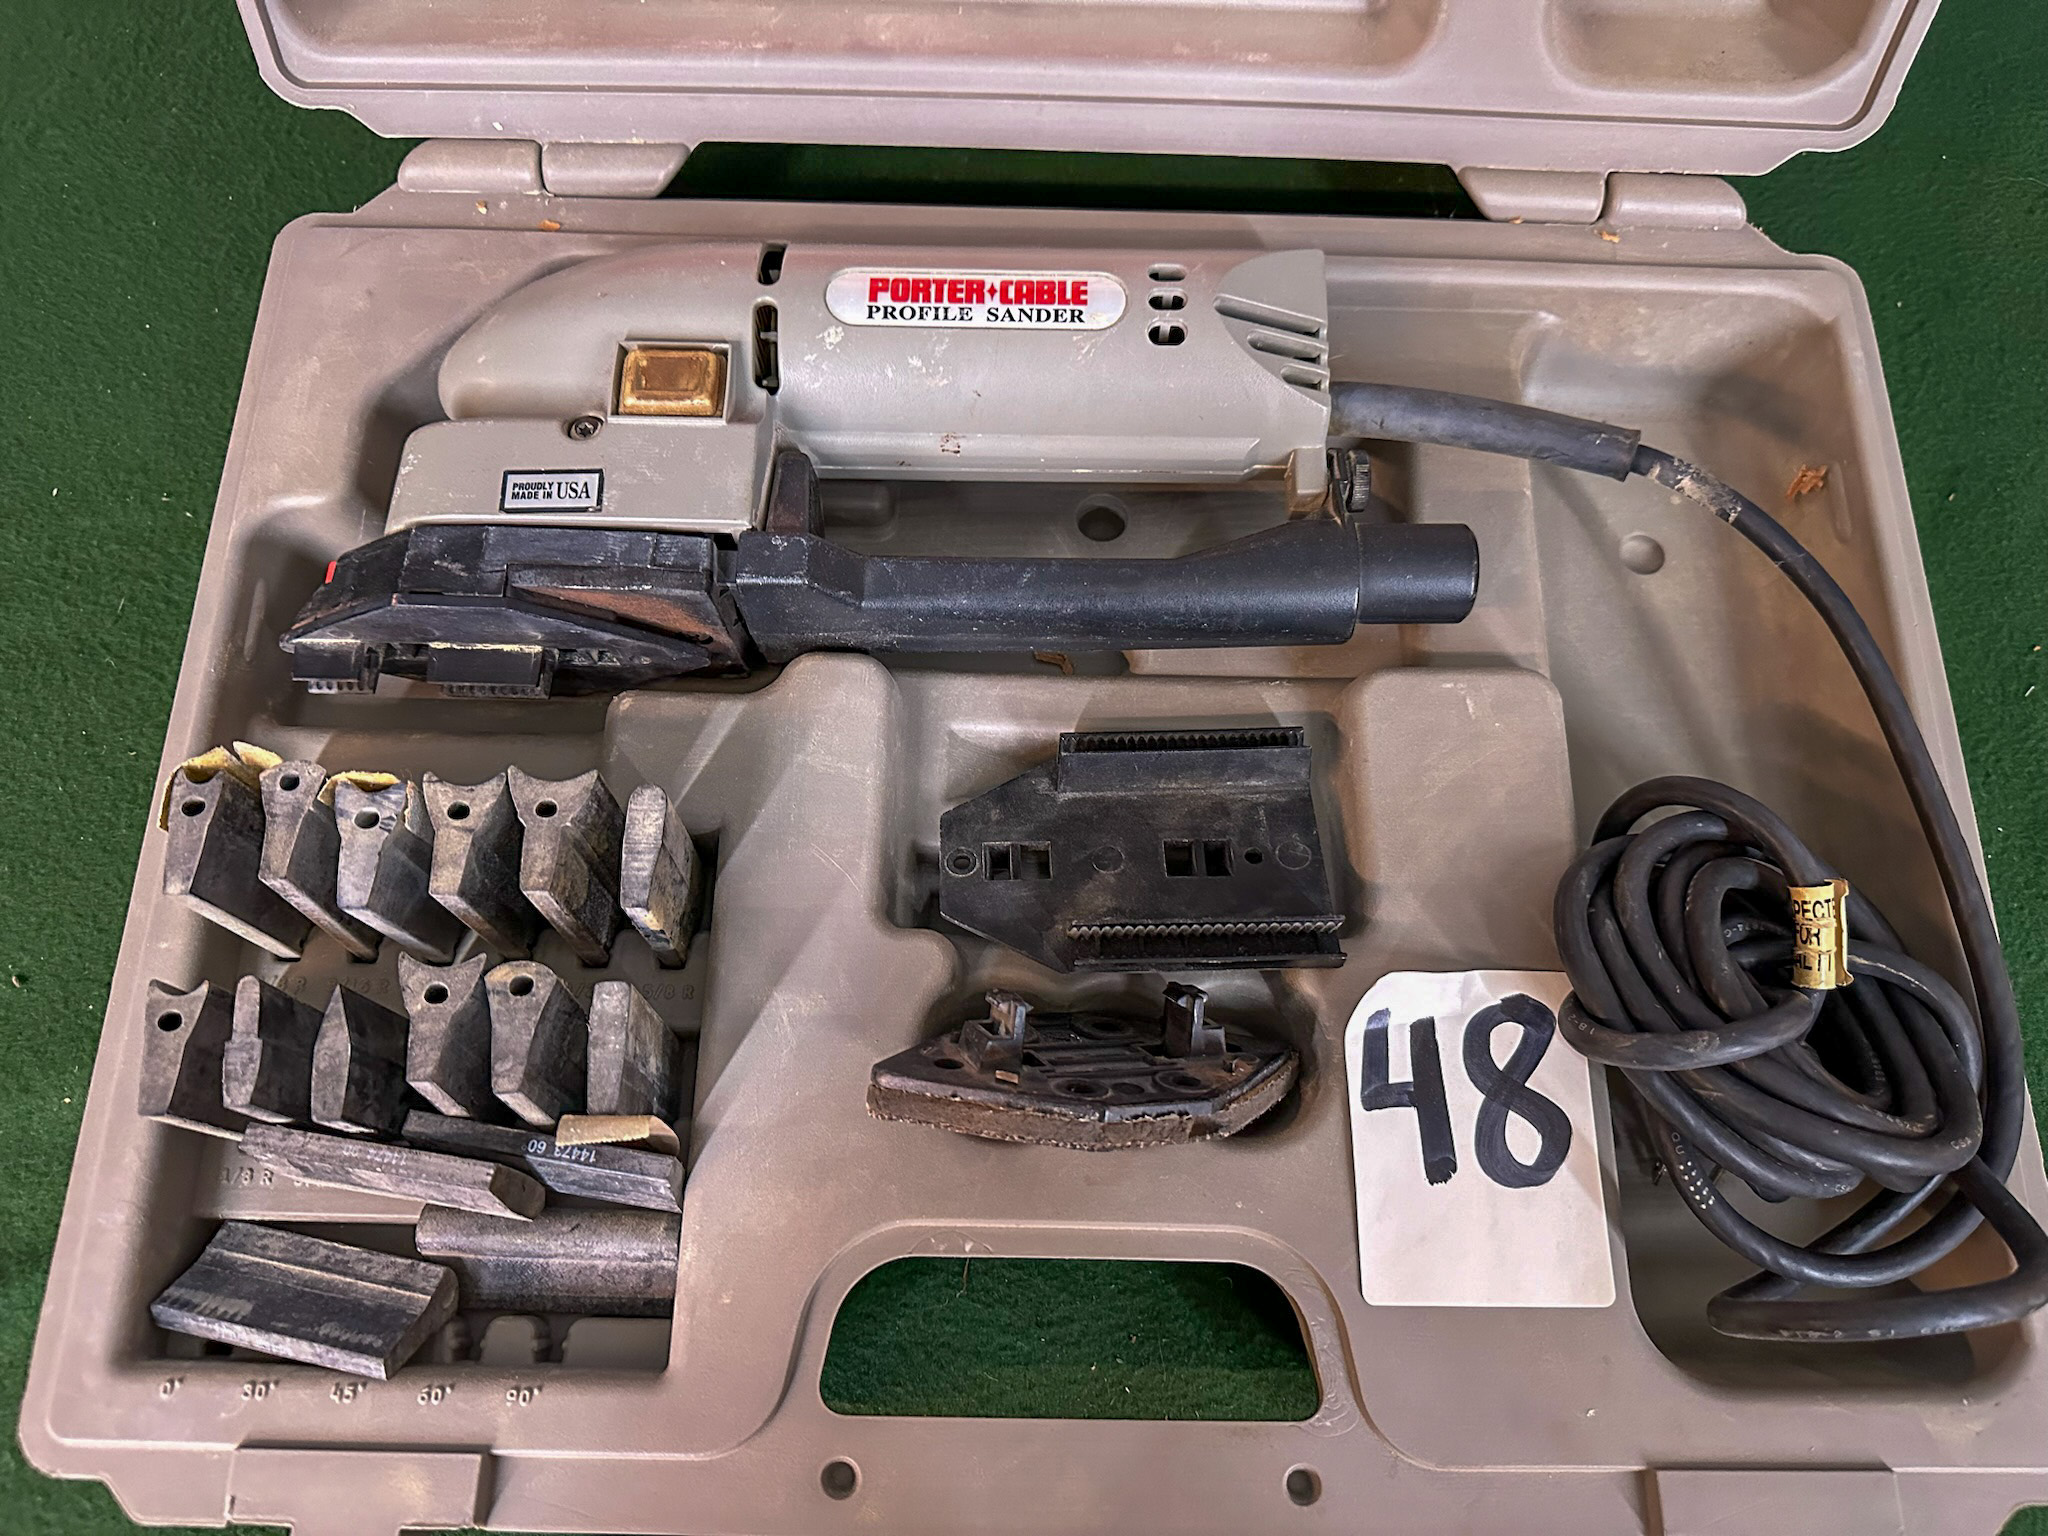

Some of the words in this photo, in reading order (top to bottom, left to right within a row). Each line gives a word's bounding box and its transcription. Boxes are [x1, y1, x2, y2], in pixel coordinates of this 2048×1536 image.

[866, 305, 974, 322] PROFILE
[986, 307, 1086, 324] SANDER
[511, 491, 540, 500] MADE
[542, 491, 553, 500] IN
[512, 482, 554, 491] PROUDLY
[557, 481, 591, 500] USA
[1361, 993, 1572, 1189] 48
